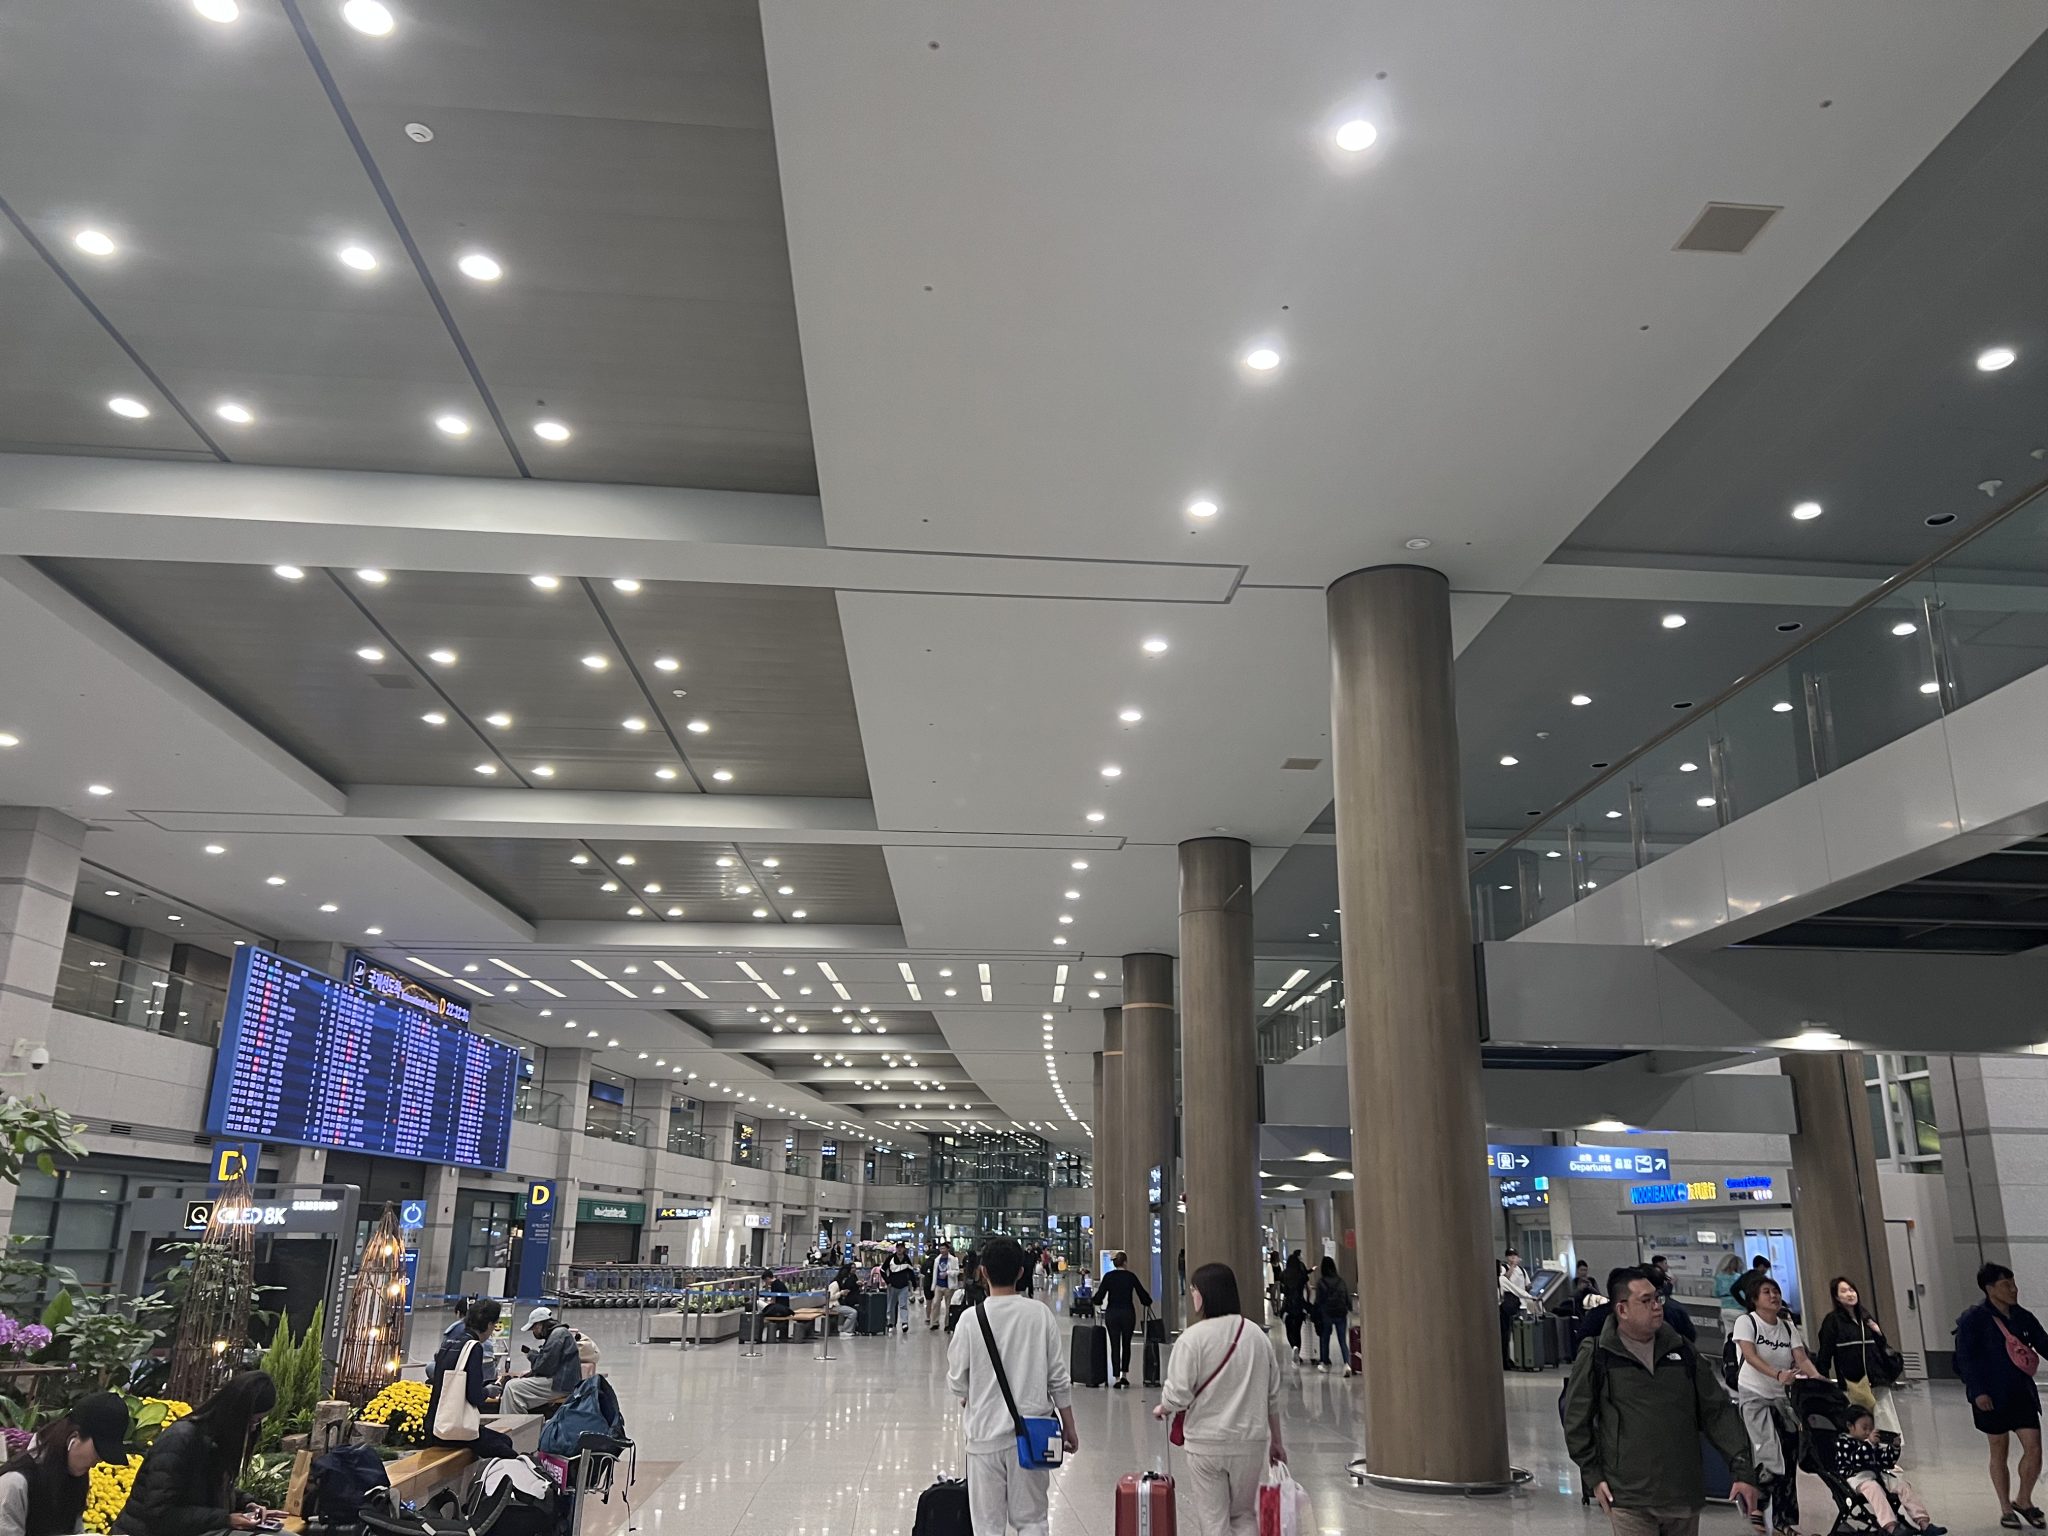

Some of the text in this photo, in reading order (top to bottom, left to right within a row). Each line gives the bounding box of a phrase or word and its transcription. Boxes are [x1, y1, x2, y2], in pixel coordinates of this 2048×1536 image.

[439, 997, 446, 1014] D
[218, 1150, 247, 1181] D
[1569, 1162, 1613, 1173] Departures
[531, 1185, 550, 1205] D
[191, 1206, 208, 1224] Q
[292, 1201, 339, 1211] SAMSUNG
[263, 1207, 288, 1225] 8K
[331, 1255, 349, 1338] SAMSUNG
